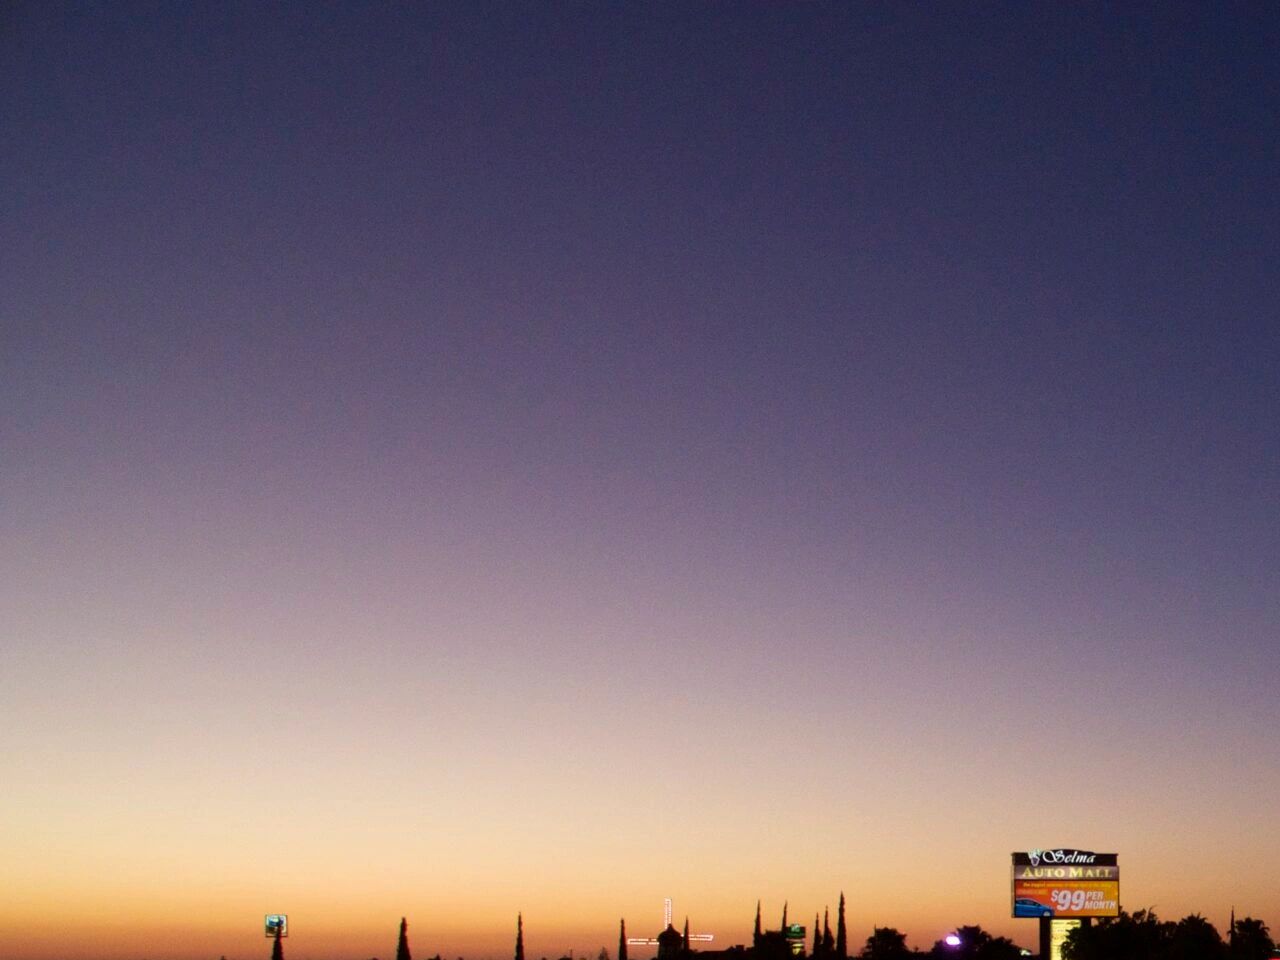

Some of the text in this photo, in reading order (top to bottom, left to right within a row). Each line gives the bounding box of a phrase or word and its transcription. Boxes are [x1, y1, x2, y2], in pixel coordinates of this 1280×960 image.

[1042, 850, 1096, 863] Selma
[1022, 867, 1112, 878] AUTO MALL
[1051, 890, 1085, 911] $99
[1086, 891, 1104, 900] PER
[1084, 900, 1116, 909] MONTH
